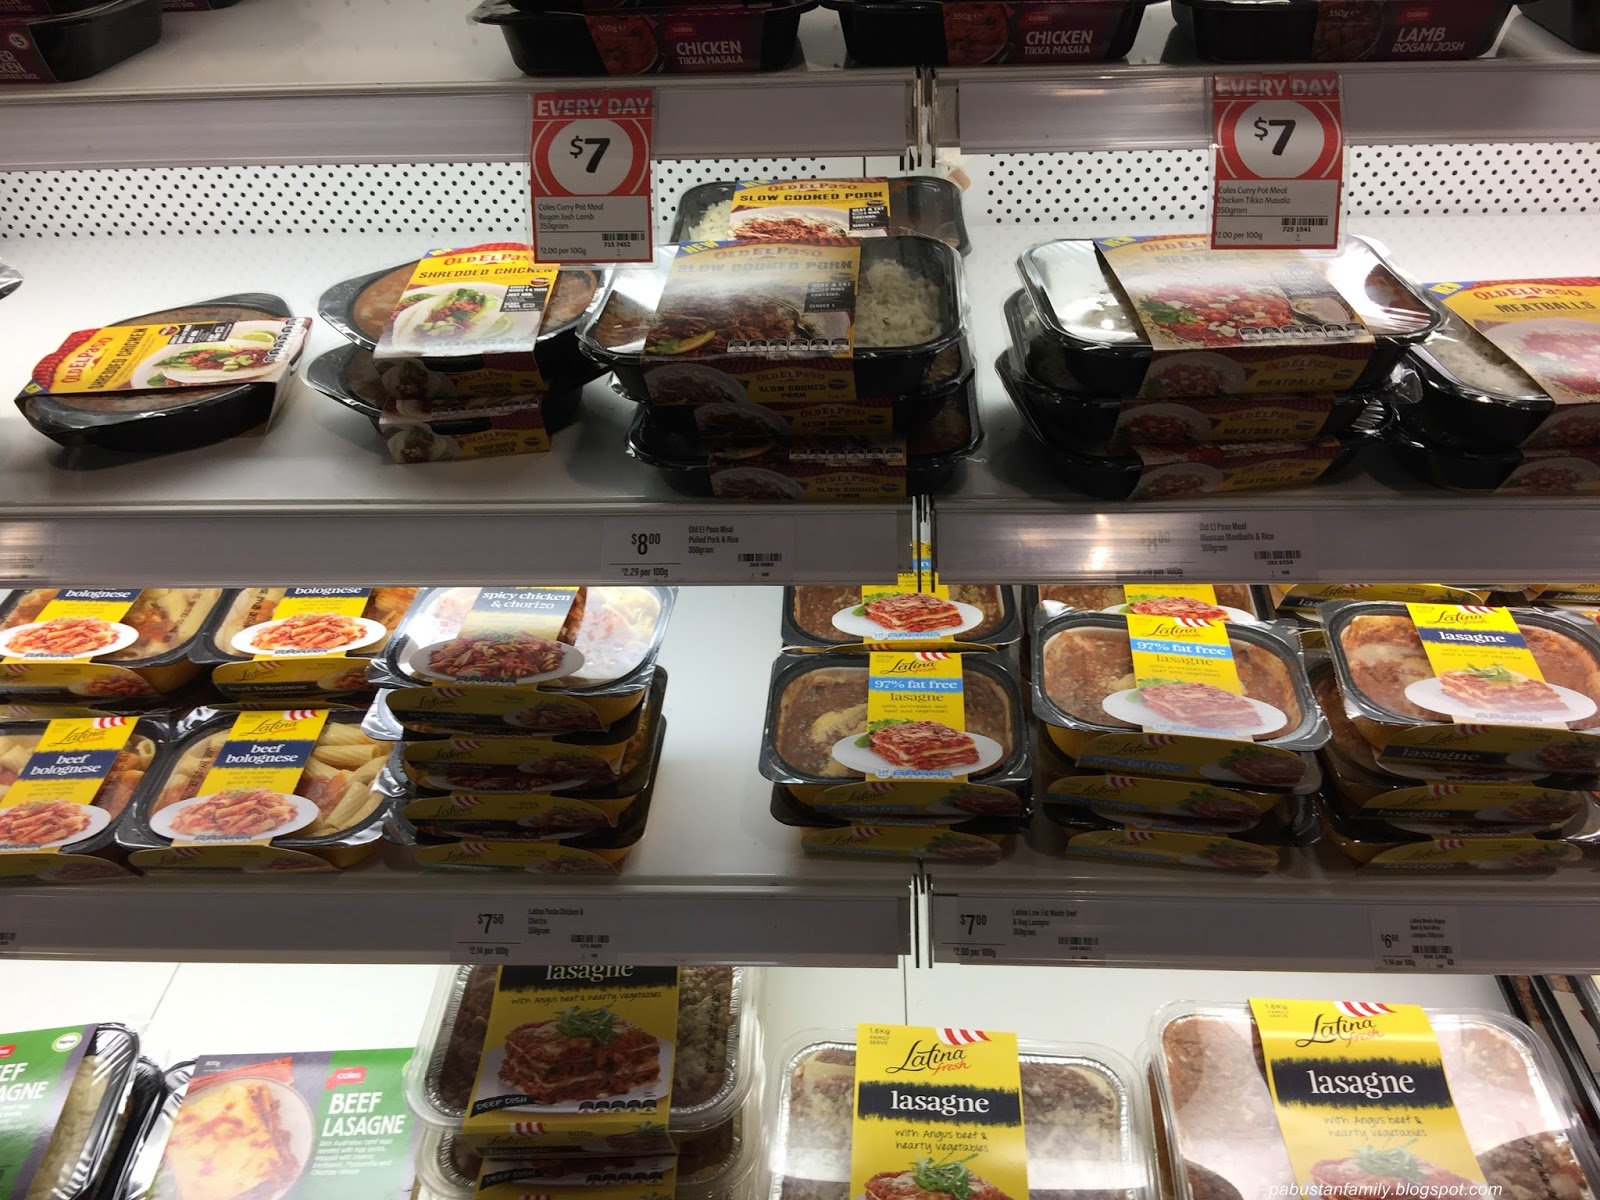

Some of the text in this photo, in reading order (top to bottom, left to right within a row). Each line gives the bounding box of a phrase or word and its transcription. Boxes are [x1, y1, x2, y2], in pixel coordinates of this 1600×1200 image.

[1328, 9, 1349, 18] 350g
[1026, 30, 1093, 45] CHICKEN
[1397, 27, 1446, 42] LAMB
[676, 40, 741, 55] CHICKEN
[1024, 46, 1090, 55] TIKKA MASALA
[1391, 41, 1465, 53] ROGAN JOSH
[677, 55, 743, 65] TIKKA MASALA
[1217, 78, 1337, 97] EVERY DAY
[537, 98, 650, 117] EVERY DAY
[1253, 115, 1297, 156] $7
[569, 135, 610, 174] $7
[740, 191, 883, 202] SLOW COOKED PORK
[1238, 187, 1256, 196] Curry
[538, 203, 605, 213] Coles Curry Pot Meal
[1217, 207, 1247, 215] 350gram
[539, 213, 594, 223] Rogan Josh Lamb
[540, 223, 569, 231] 350gram
[1247, 232, 1263, 240] 100g
[571, 248, 587, 256] 100g
[681, 241, 719, 254] NEW
[444, 254, 501, 266] OLD EL
[714, 250, 751, 260] OLD
[753, 248, 778, 257] EL
[677, 260, 853, 273] SLOW COOKED PORK
[419, 269, 489, 279] SHREDDED
[1473, 290, 1505, 301] OLD
[1507, 287, 1532, 298] EL
[1494, 301, 1597, 313] MEATBALLS
[61, 368, 83, 383] OLD
[788, 384, 826, 392] COOKED
[1256, 378, 1327, 387] MEATBALLS
[640, 569, 651, 578] per
[65, 589, 131, 599] bolognese
[294, 587, 362, 596] bolognese
[482, 590, 571, 602] spicy chicken
[490, 600, 555, 610] & chorizo
[1426, 611, 1483, 624] Latina
[1141, 623, 1199, 638] Latina
[1438, 631, 1507, 644] lasagne
[1137, 641, 1227, 656] 97% fat free
[880, 658, 936, 675] Latina
[1156, 654, 1214, 667] lasagne
[874, 679, 958, 689] 97% fat free
[890, 693, 944, 703] lasagne
[239, 719, 298, 737] Latina
[48, 727, 106, 747] Latina
[250, 744, 285, 754] beef
[1400, 748, 1480, 761] lasagne
[56, 754, 91, 765] beef
[225, 753, 299, 765] bolognese
[30, 765, 102, 777] bolognese
[1377, 809, 1451, 818] lasagne
[544, 964, 634, 983] lasagne
[534, 997, 558, 1006] Angus
[560, 995, 578, 1003] beef
[587, 994, 617, 1003] hearty
[620, 991, 662, 1001] vegetables
[1265, 1003, 1288, 1011] 1.6Kg
[869, 1028, 890, 1036] 1.6Kg
[1295, 1013, 1377, 1048] Latina
[1346, 1028, 1385, 1048] fresh
[885, 1040, 966, 1074] Latina
[932, 1060, 972, 1076] fresh
[337, 1071, 361, 1080] coles
[1306, 1070, 1416, 1100] lasagne
[0, 1081, 49, 1102] AGNE
[329, 1092, 383, 1115] BEEF
[476, 1097, 528, 1111] DEEP DISH
[890, 1090, 990, 1116] lasagne
[321, 1114, 406, 1137] LASAGNE
[1324, 1116, 1423, 1128] with Angus beef &
[895, 1129, 988, 1141] with Angus beef &
[1328, 1128, 1428, 1141] hearty vegetables
[895, 1140, 990, 1154] hearty vegetables
